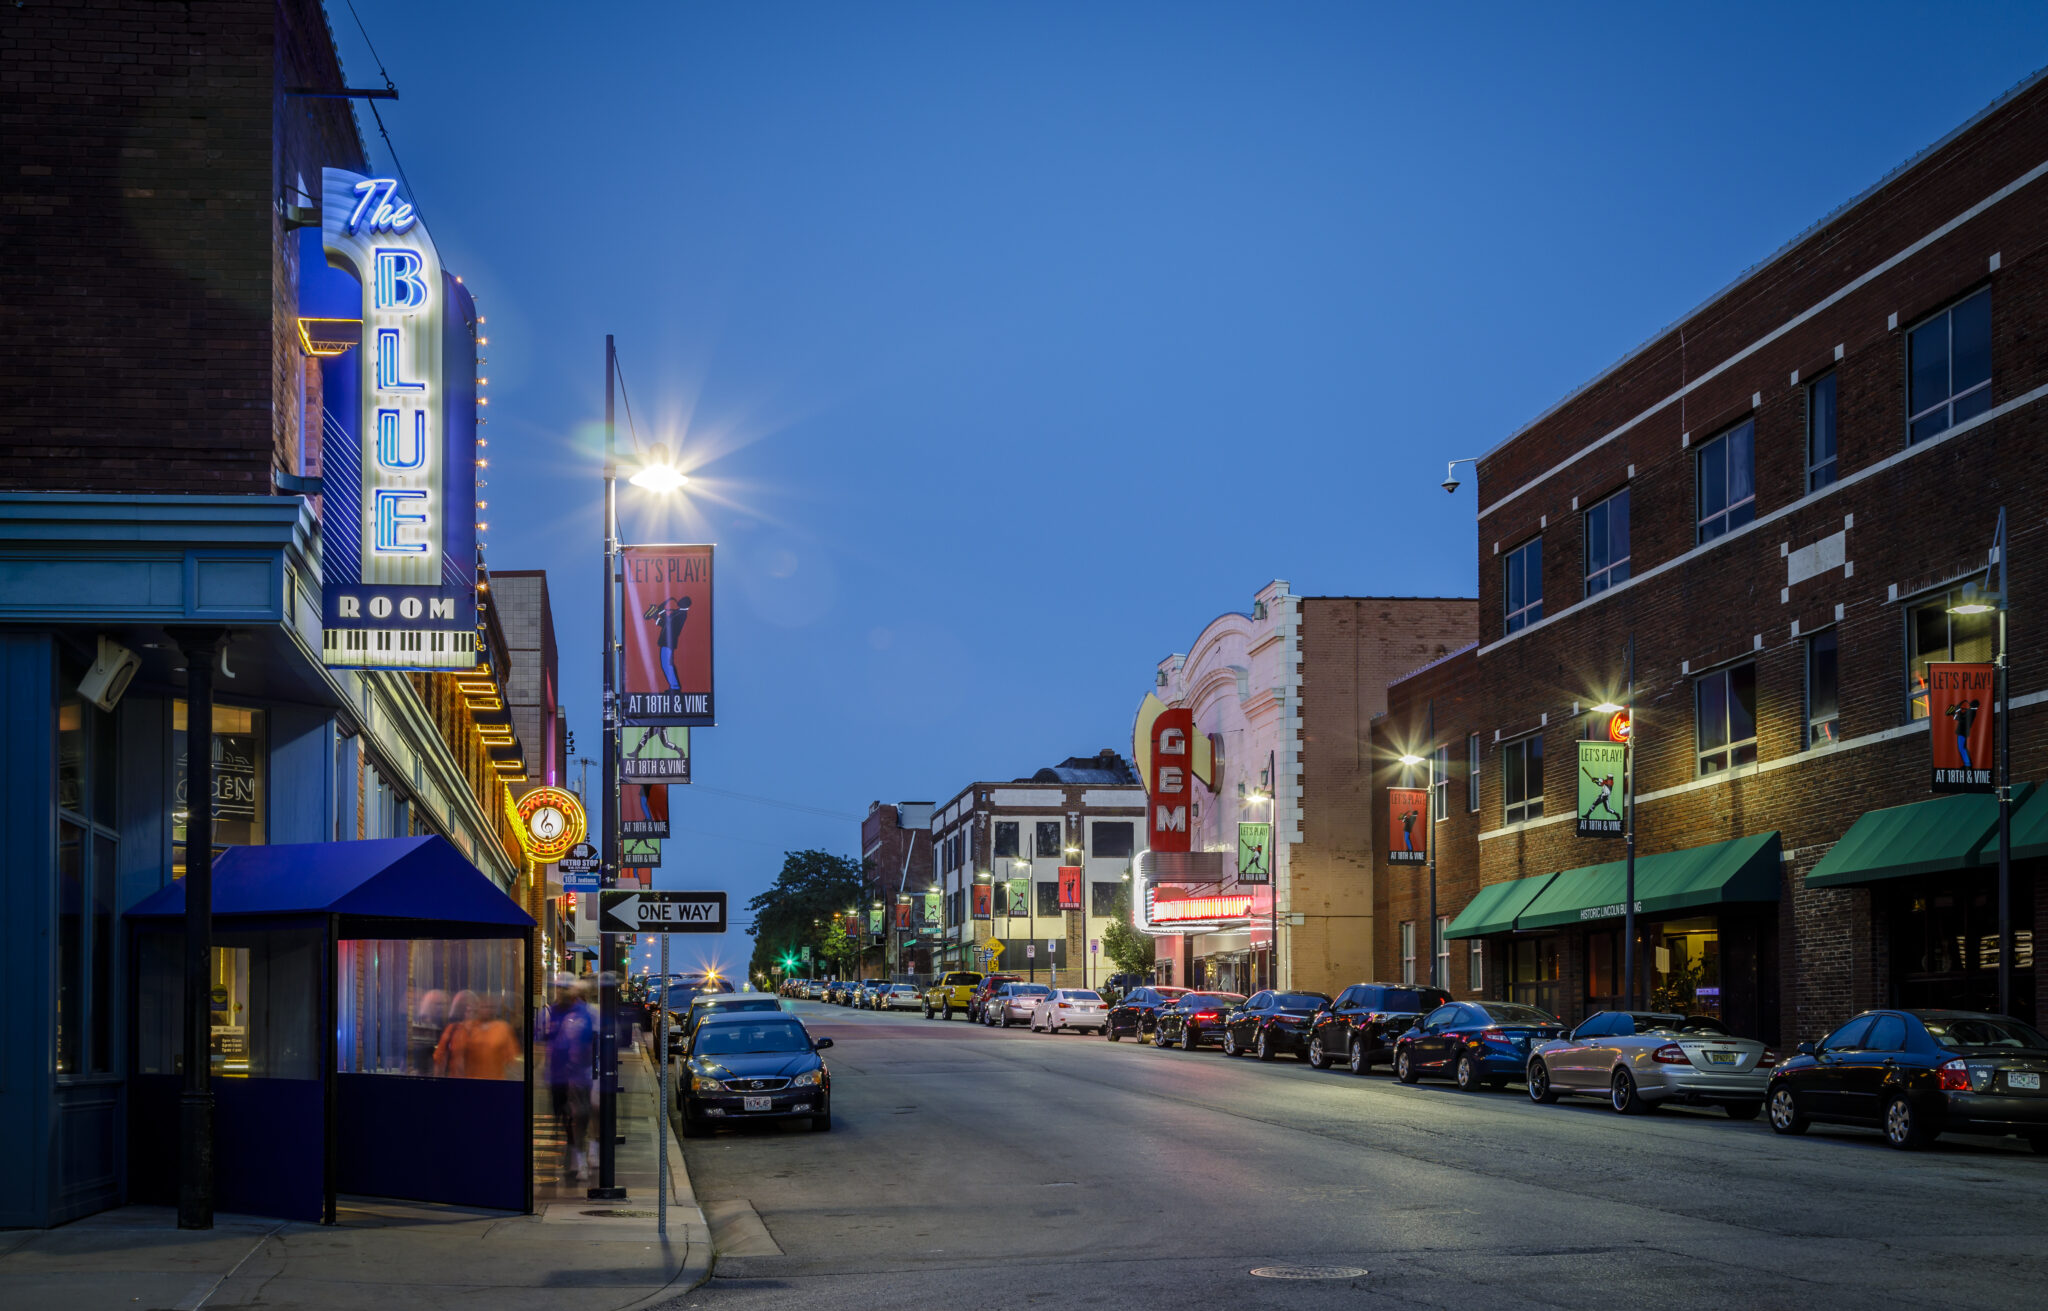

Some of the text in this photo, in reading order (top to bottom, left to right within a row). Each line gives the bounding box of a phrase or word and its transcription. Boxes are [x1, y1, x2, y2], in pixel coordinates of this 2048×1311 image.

[349, 178, 416, 236] The
[373, 246, 429, 555] BLUE
[628, 557, 706, 583] LET'S PLAY!
[339, 596, 455, 619] ROOM
[1933, 672, 1991, 689] LET'S PLAY!
[629, 695, 708, 713] AT 18TH & VINE
[1581, 748, 1622, 763] LET'S PLAY!
[625, 760, 686, 774] AT 18TH & VINE
[1156, 728, 1186, 832] GEM
[1935, 770, 1991, 783] AT 18TH & VINE
[624, 822, 631, 832] AT
[633, 822, 647, 832] 18TH
[654, 821, 667, 832] VINE
[1580, 820, 1588, 831] AT
[1590, 820, 1602, 831] 18TH
[1609, 820, 1622, 831] VINE
[638, 904, 713, 920] ONE WAY
[1581, 907, 1600, 920] HISTORIC
[1601, 904, 1619, 917] LINCOLN
